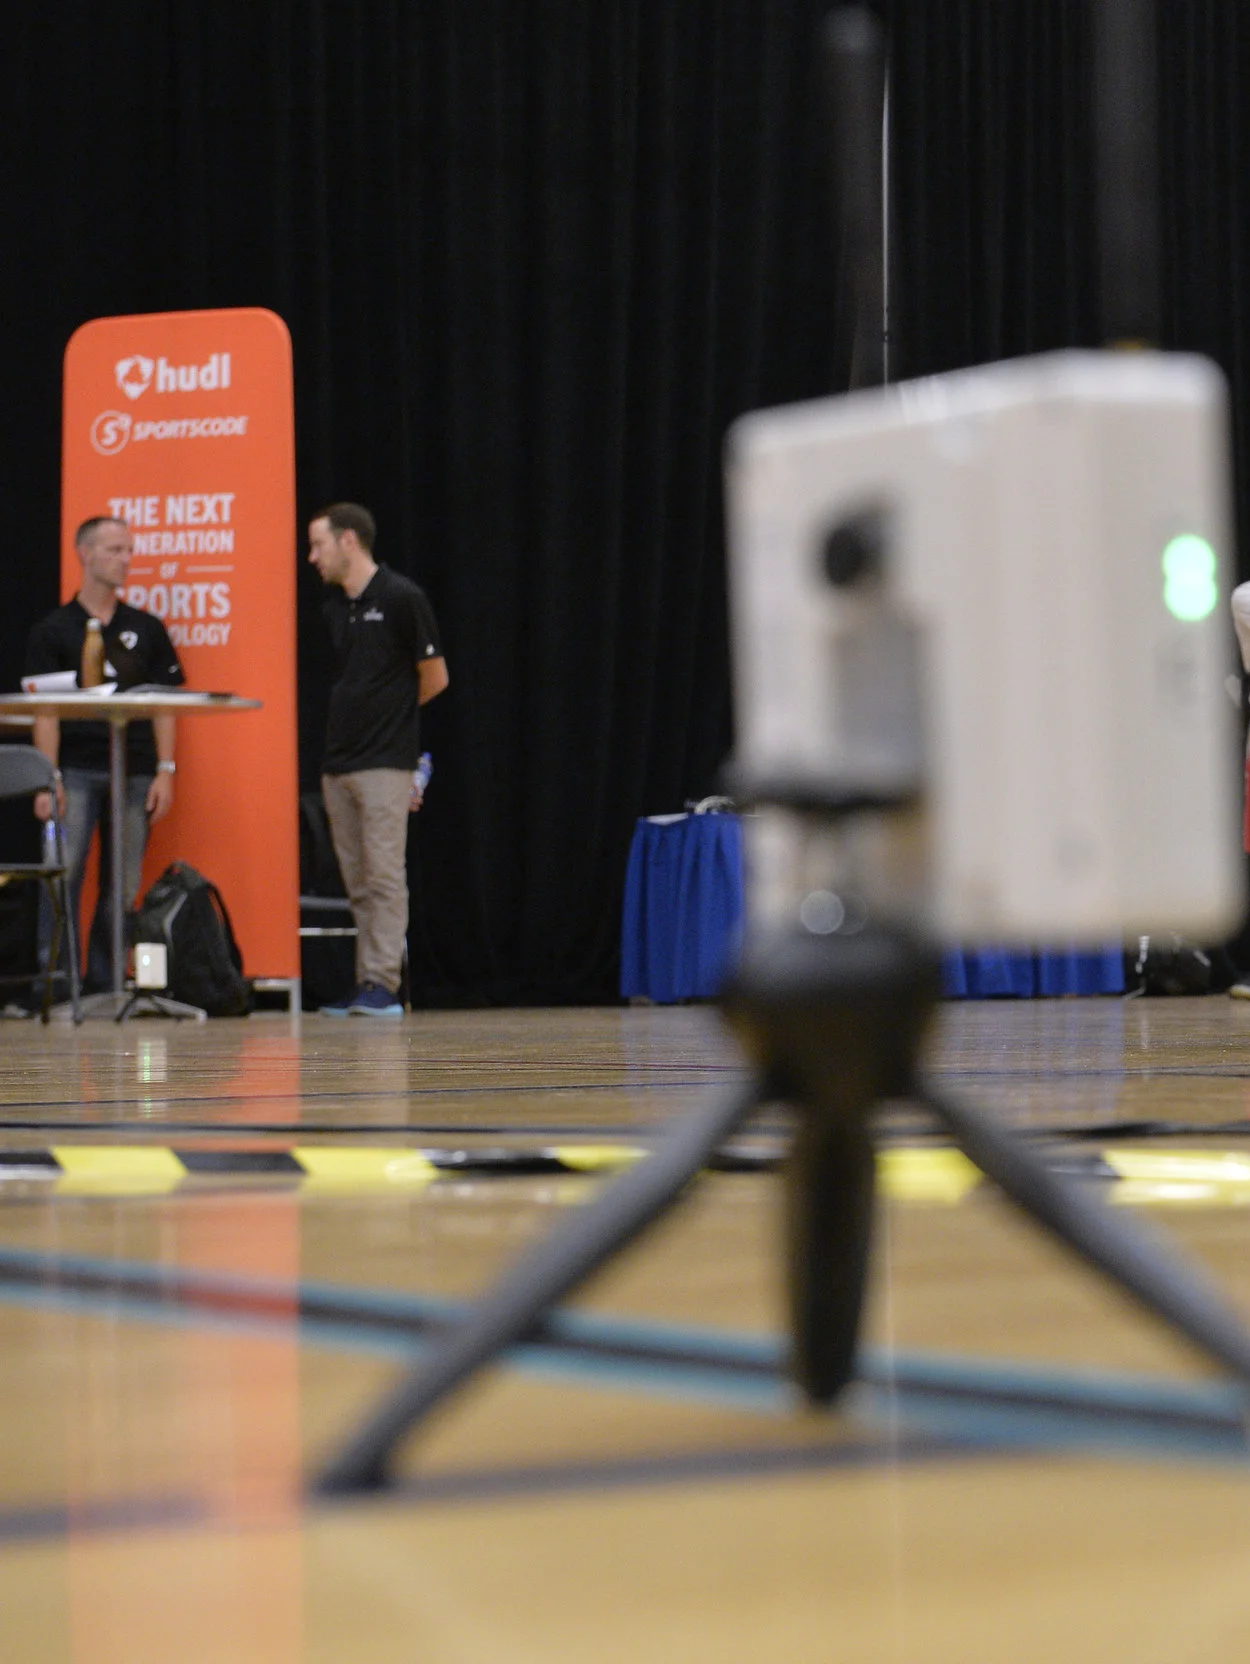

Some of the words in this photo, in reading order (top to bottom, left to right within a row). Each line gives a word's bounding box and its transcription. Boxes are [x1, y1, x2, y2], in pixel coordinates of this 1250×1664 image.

[156, 352, 231, 393] hudl
[133, 415, 249, 442] SPORTSCODE
[108, 496, 160, 527] THE
[166, 493, 236, 526] NEXT
[133, 529, 235, 556] NERATION
[159, 561, 180, 580] OF
[115, 581, 231, 619] PORTS
[167, 622, 232, 648] OLOGY
